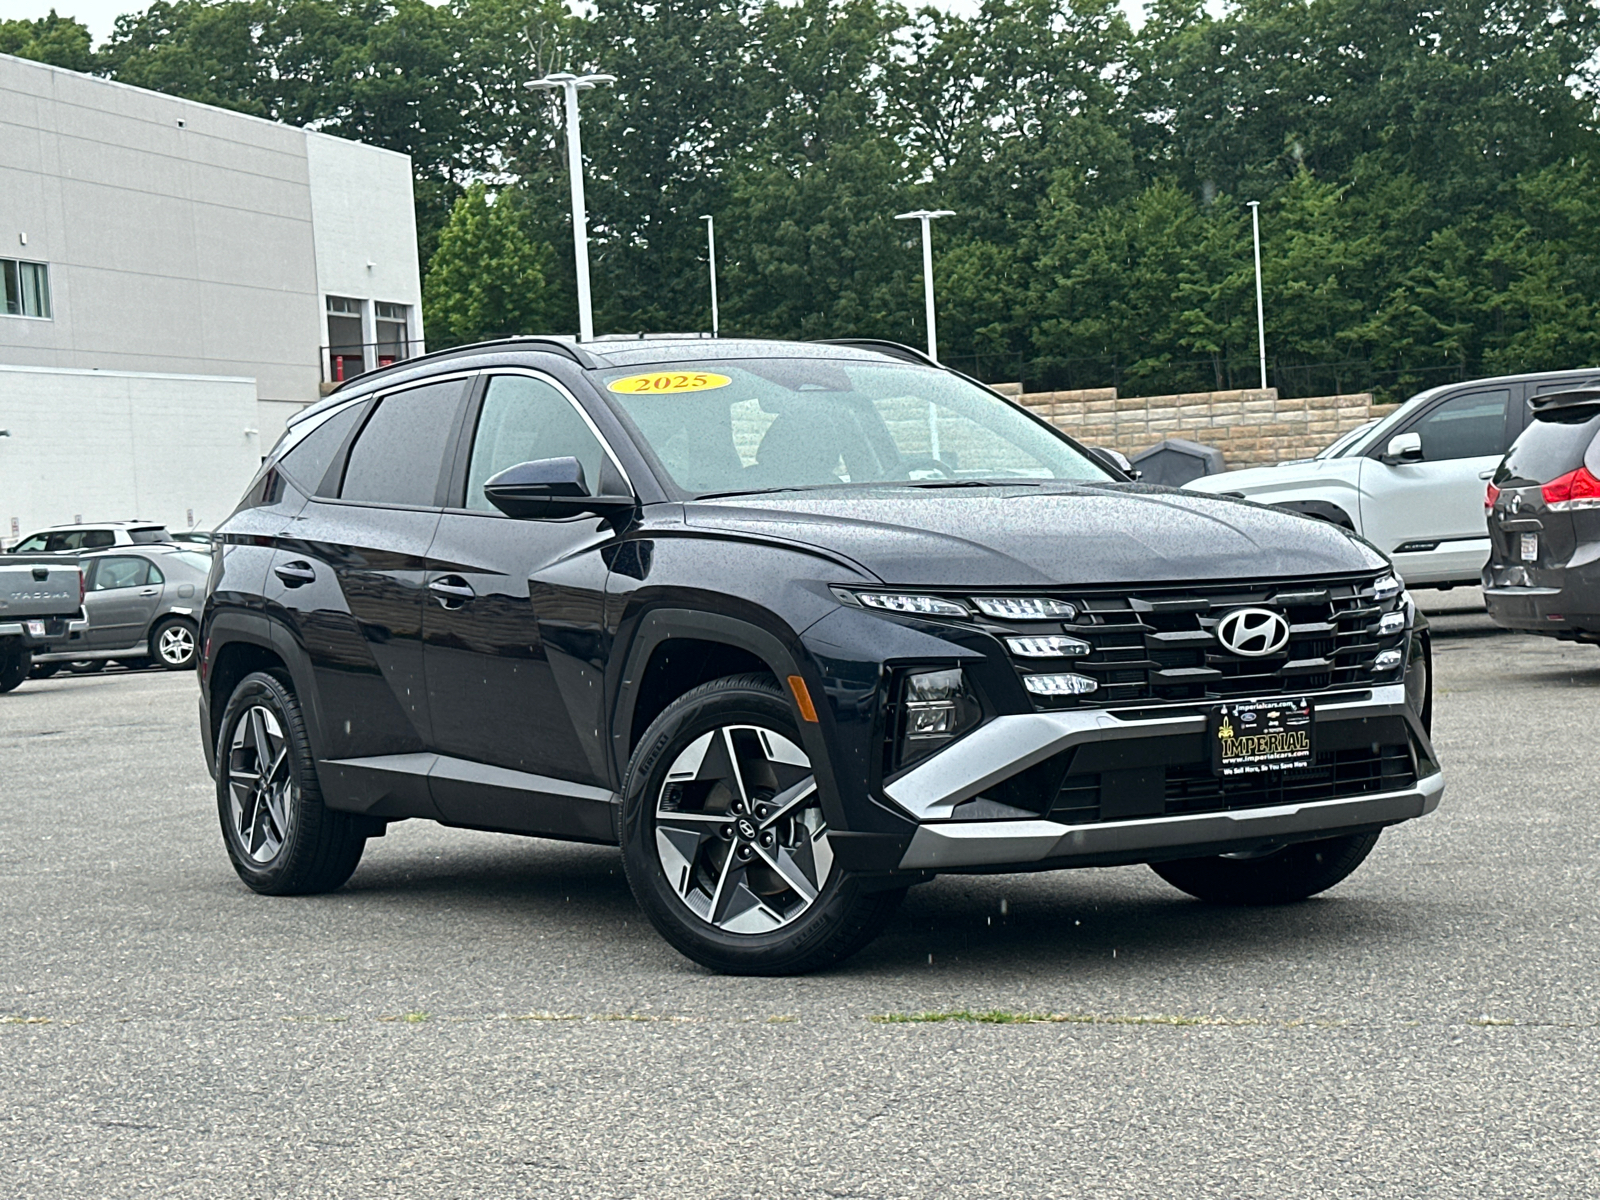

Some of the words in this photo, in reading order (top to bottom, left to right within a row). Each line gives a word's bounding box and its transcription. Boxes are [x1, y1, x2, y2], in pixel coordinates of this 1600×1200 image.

[634, 374, 708, 392] 2025
[10, 591, 70, 600] TACOMA
[1222, 731, 1310, 758] IMPERIAL
[1222, 750, 1310, 764] www.imperialcars.com
